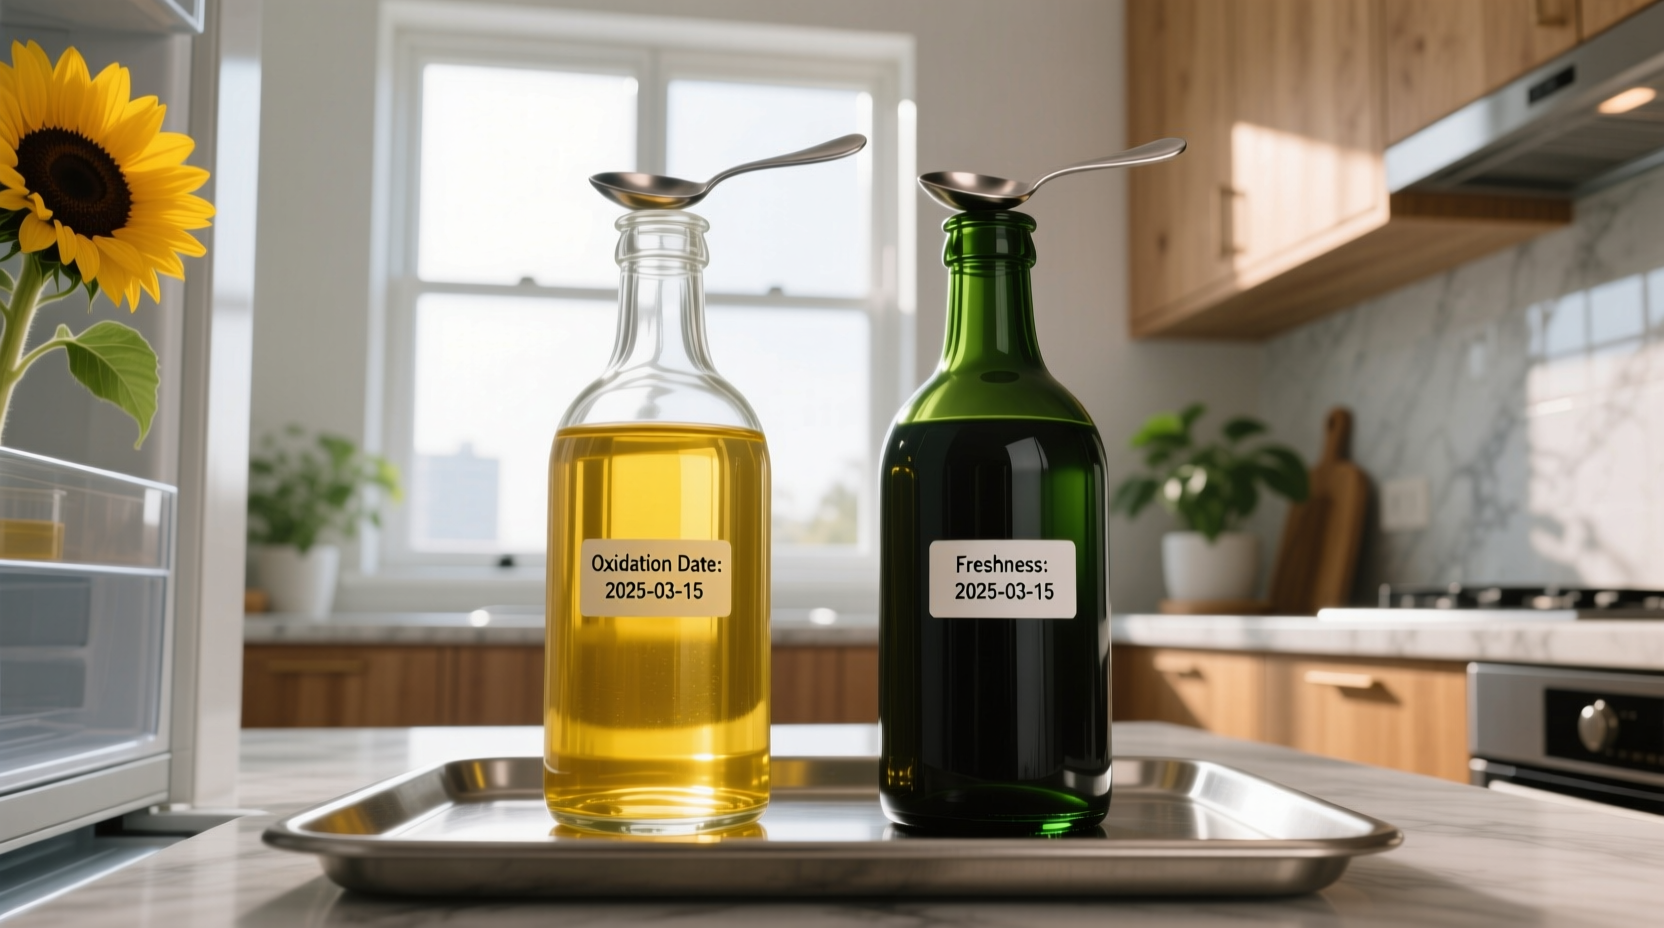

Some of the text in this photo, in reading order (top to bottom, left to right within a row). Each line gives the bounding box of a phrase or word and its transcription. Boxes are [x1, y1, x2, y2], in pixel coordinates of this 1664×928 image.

[591, 553, 722, 573] Oxidation Date:
[956, 554, 1048, 573] Freshness:
[605, 581, 704, 599] 2025-03-15
[955, 582, 1054, 600] 2025-03-15
